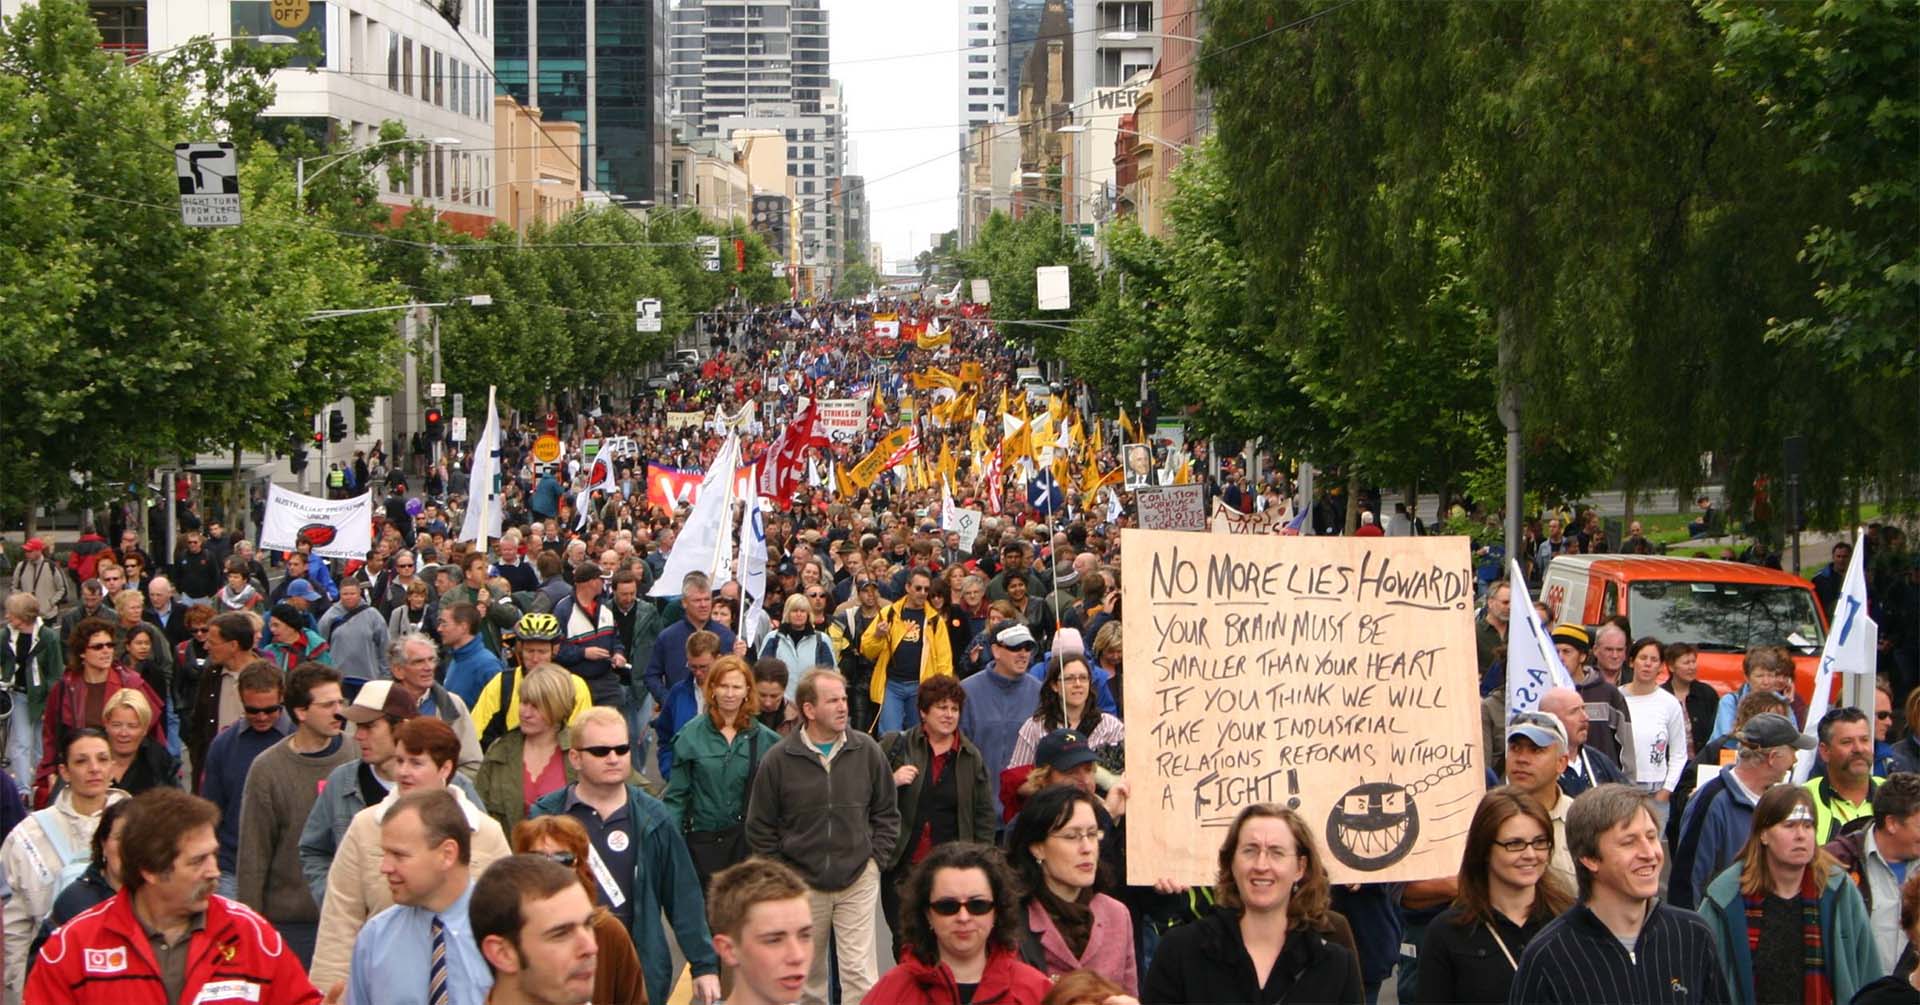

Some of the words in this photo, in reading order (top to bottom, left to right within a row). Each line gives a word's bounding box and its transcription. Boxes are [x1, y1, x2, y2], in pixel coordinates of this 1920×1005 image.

[274, 8, 303, 20] OFF
[823, 409, 849, 417] STRIKES
[851, 409, 861, 417] CAN
[831, 418, 858, 427] HOWARD
[1139, 490, 1198, 503] COALITION
[1144, 498, 1195, 510] WORKPLACE
[1144, 510, 1203, 522] EXPLOITS
[1148, 519, 1204, 530] WORKERS
[1150, 546, 1198, 600] NO
[1207, 553, 1284, 600] MORE
[1287, 564, 1355, 595] LIES
[1153, 613, 1212, 652] YOUR
[1224, 611, 1287, 647] BRAIN
[1291, 610, 1352, 646] MUST
[1358, 613, 1395, 645] BE
[1152, 654, 1247, 682] SMALLER
[1255, 648, 1310, 677] THAN
[1314, 651, 1358, 676] YOUR
[1366, 647, 1447, 681] HEART
[1155, 686, 1196, 716] IF
[1204, 687, 1260, 713] YOU
[1265, 682, 1335, 712] THINK
[1342, 684, 1377, 708] WE
[1388, 685, 1447, 709] WILL
[1150, 718, 1205, 749] TAKE
[1217, 719, 1266, 748] YOUR
[1273, 713, 1409, 738] INDUSTRIAL
[1156, 748, 1264, 778] RELATIONS
[1279, 742, 1376, 766] REFORMS
[1390, 738, 1475, 767] WITHOUT
[1161, 784, 1175, 810] A
[1193, 767, 1301, 819] FIGHT!
